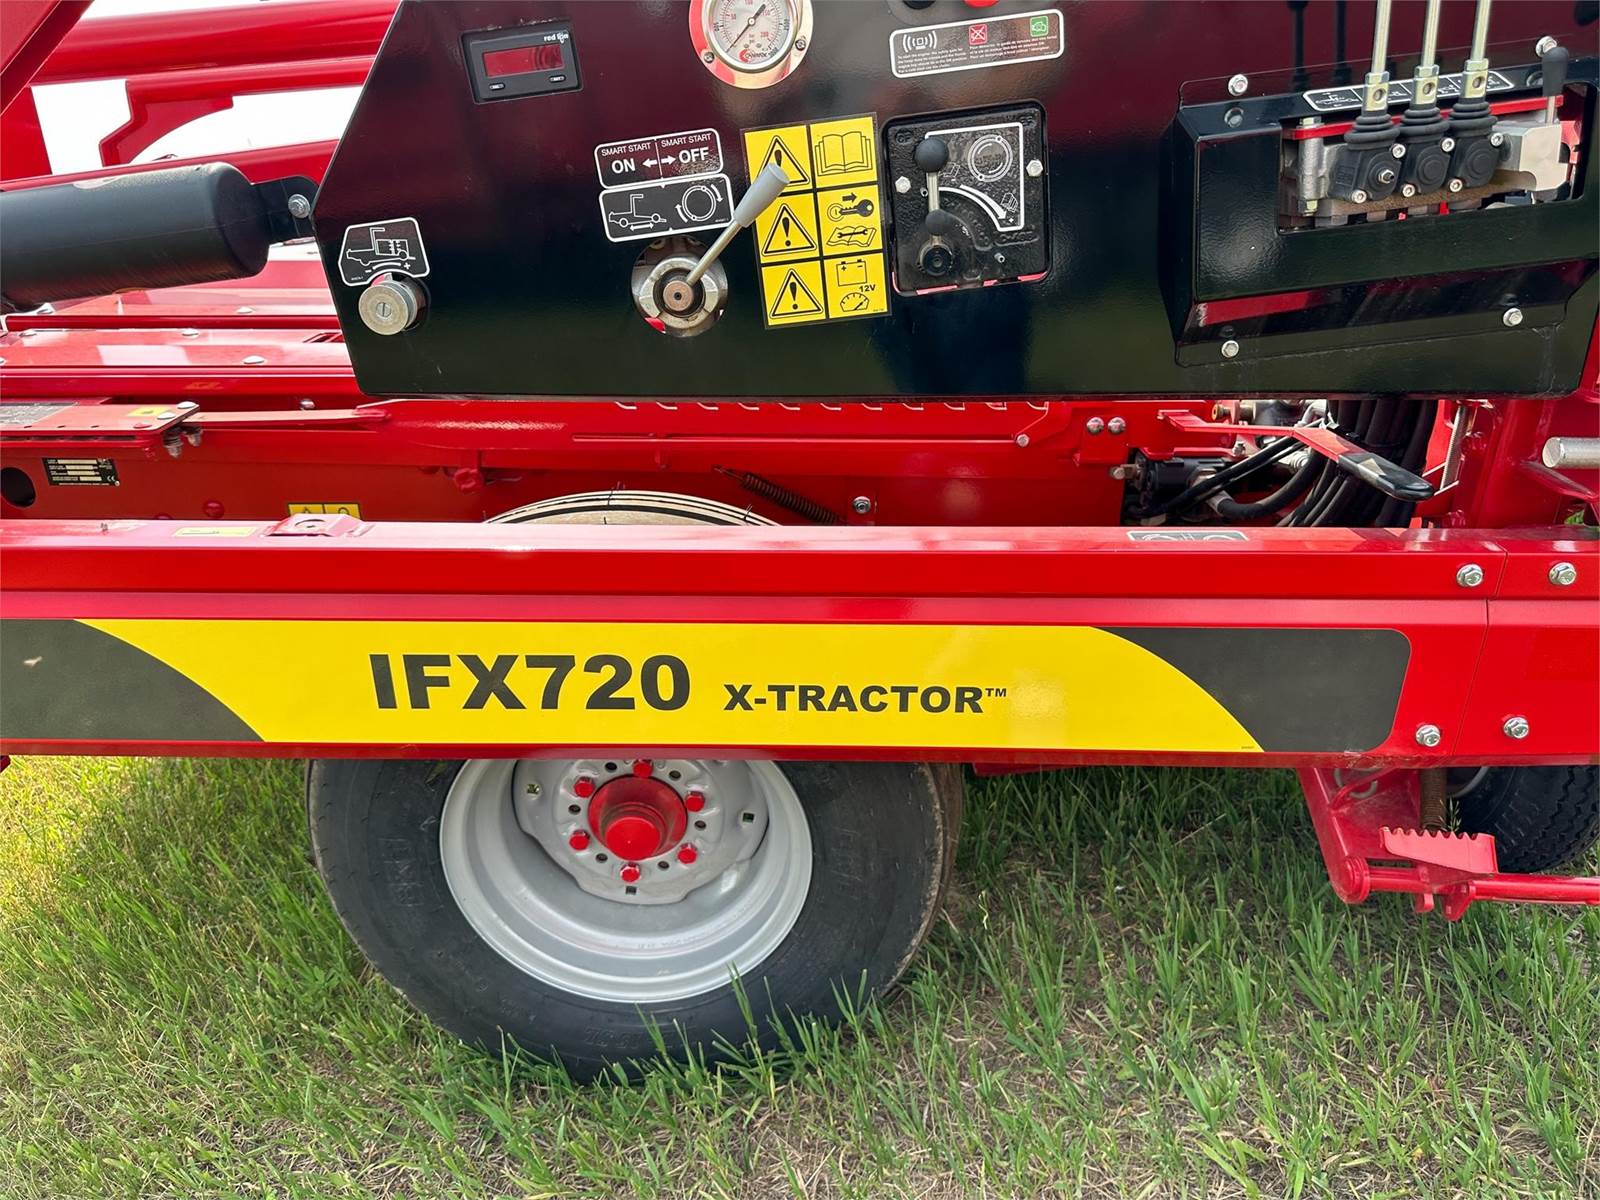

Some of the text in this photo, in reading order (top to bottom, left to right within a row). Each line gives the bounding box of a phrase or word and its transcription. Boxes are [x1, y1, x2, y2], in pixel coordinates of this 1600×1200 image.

[543, 33, 556, 41] red
[661, 133, 712, 148] SMART START
[601, 142, 651, 156] SMART START
[678, 147, 709, 164] OFF
[612, 159, 636, 174] ON
[859, 284, 876, 293] 12V
[369, 654, 691, 711] IFX720
